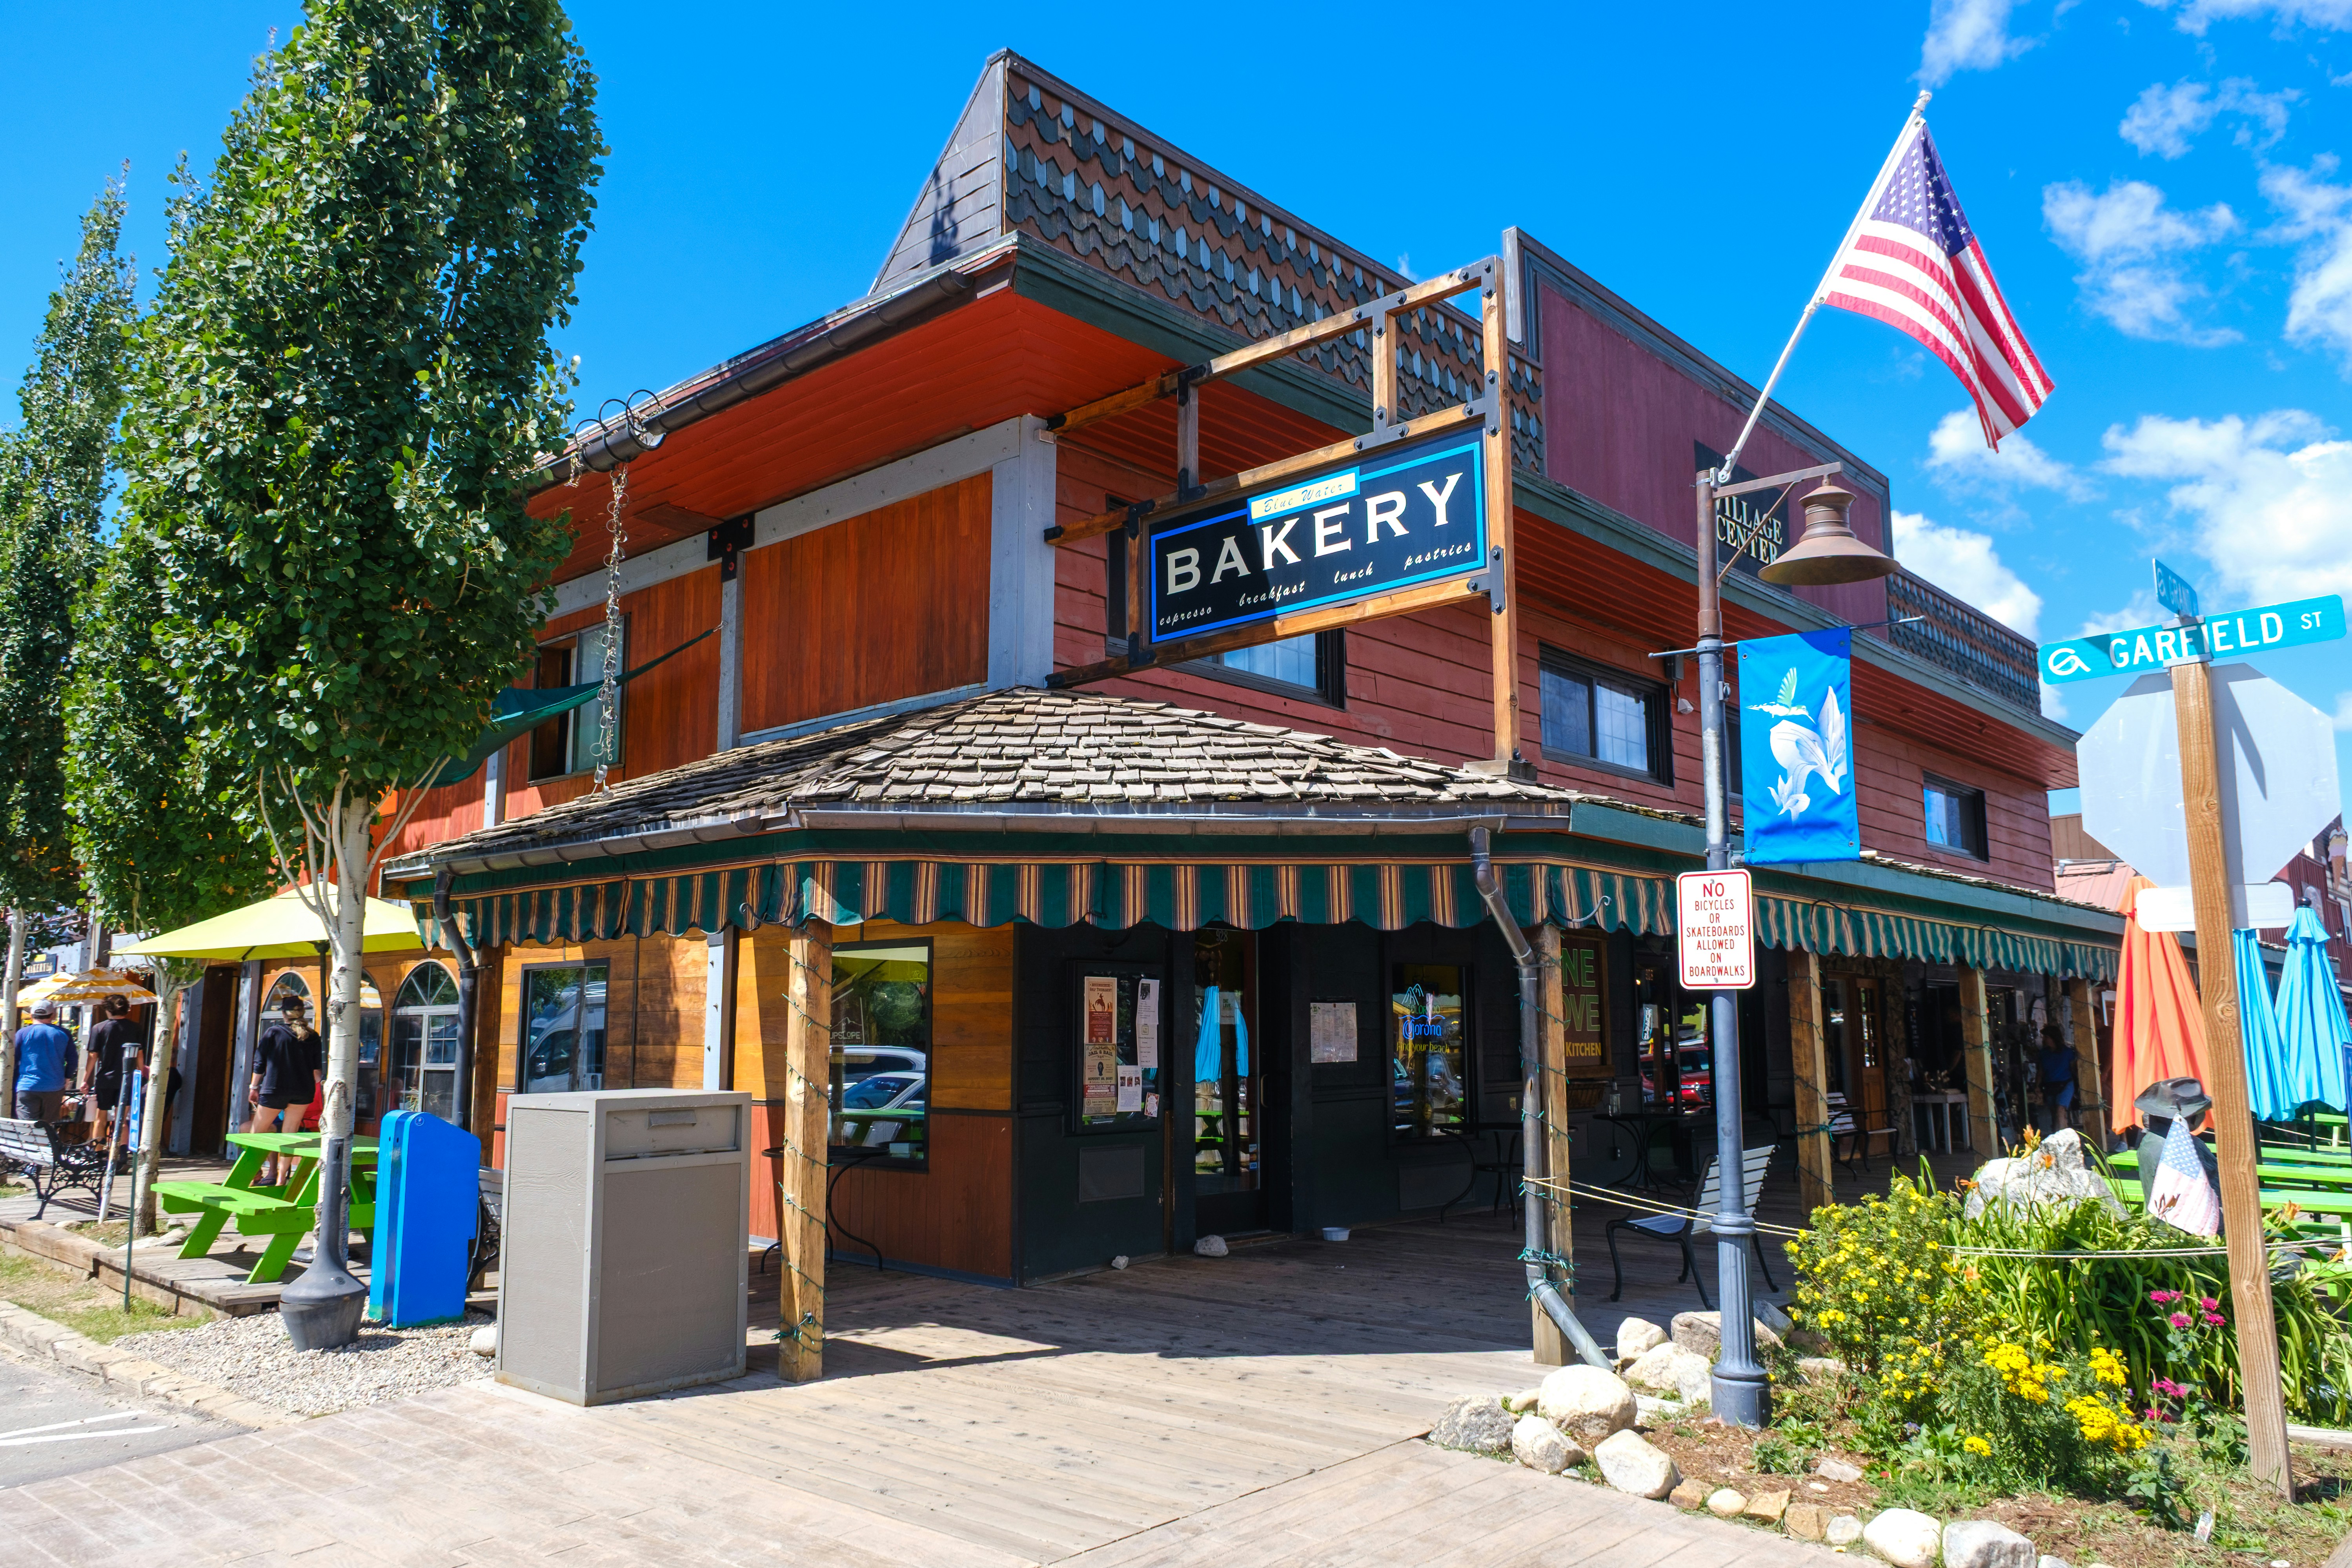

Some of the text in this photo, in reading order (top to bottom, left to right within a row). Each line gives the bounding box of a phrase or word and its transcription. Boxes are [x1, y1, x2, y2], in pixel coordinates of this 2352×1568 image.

[1264, 484, 1342, 512] Blue Water
[1167, 472, 1463, 595] BAKERY
[1717, 515, 1777, 564] CENTER
[1160, 541, 1472, 626] espresso breakfast lunch pastries
[2110, 611, 2322, 668] GARFIELD ST
[1703, 883, 1724, 897] NO
[1695, 899, 1734, 911] BICYCLES
[1709, 913, 1720, 923] OR
[1216, 930, 1227, 942] 928
[1686, 925, 1745, 937] SKATEBOARDS
[1697, 939, 1735, 950] ALLOWED
[1711, 952, 1721, 963] ON
[1562, 948, 1595, 987] NE
[1689, 965, 1745, 977] BOARDWALKS
[1407, 1005, 1441, 1014] COLORDO
[1403, 1019, 1442, 1040] Corona
[1396, 1040, 1449, 1053] Find your beach
[1566, 1042, 1601, 1057] KITCHEN
